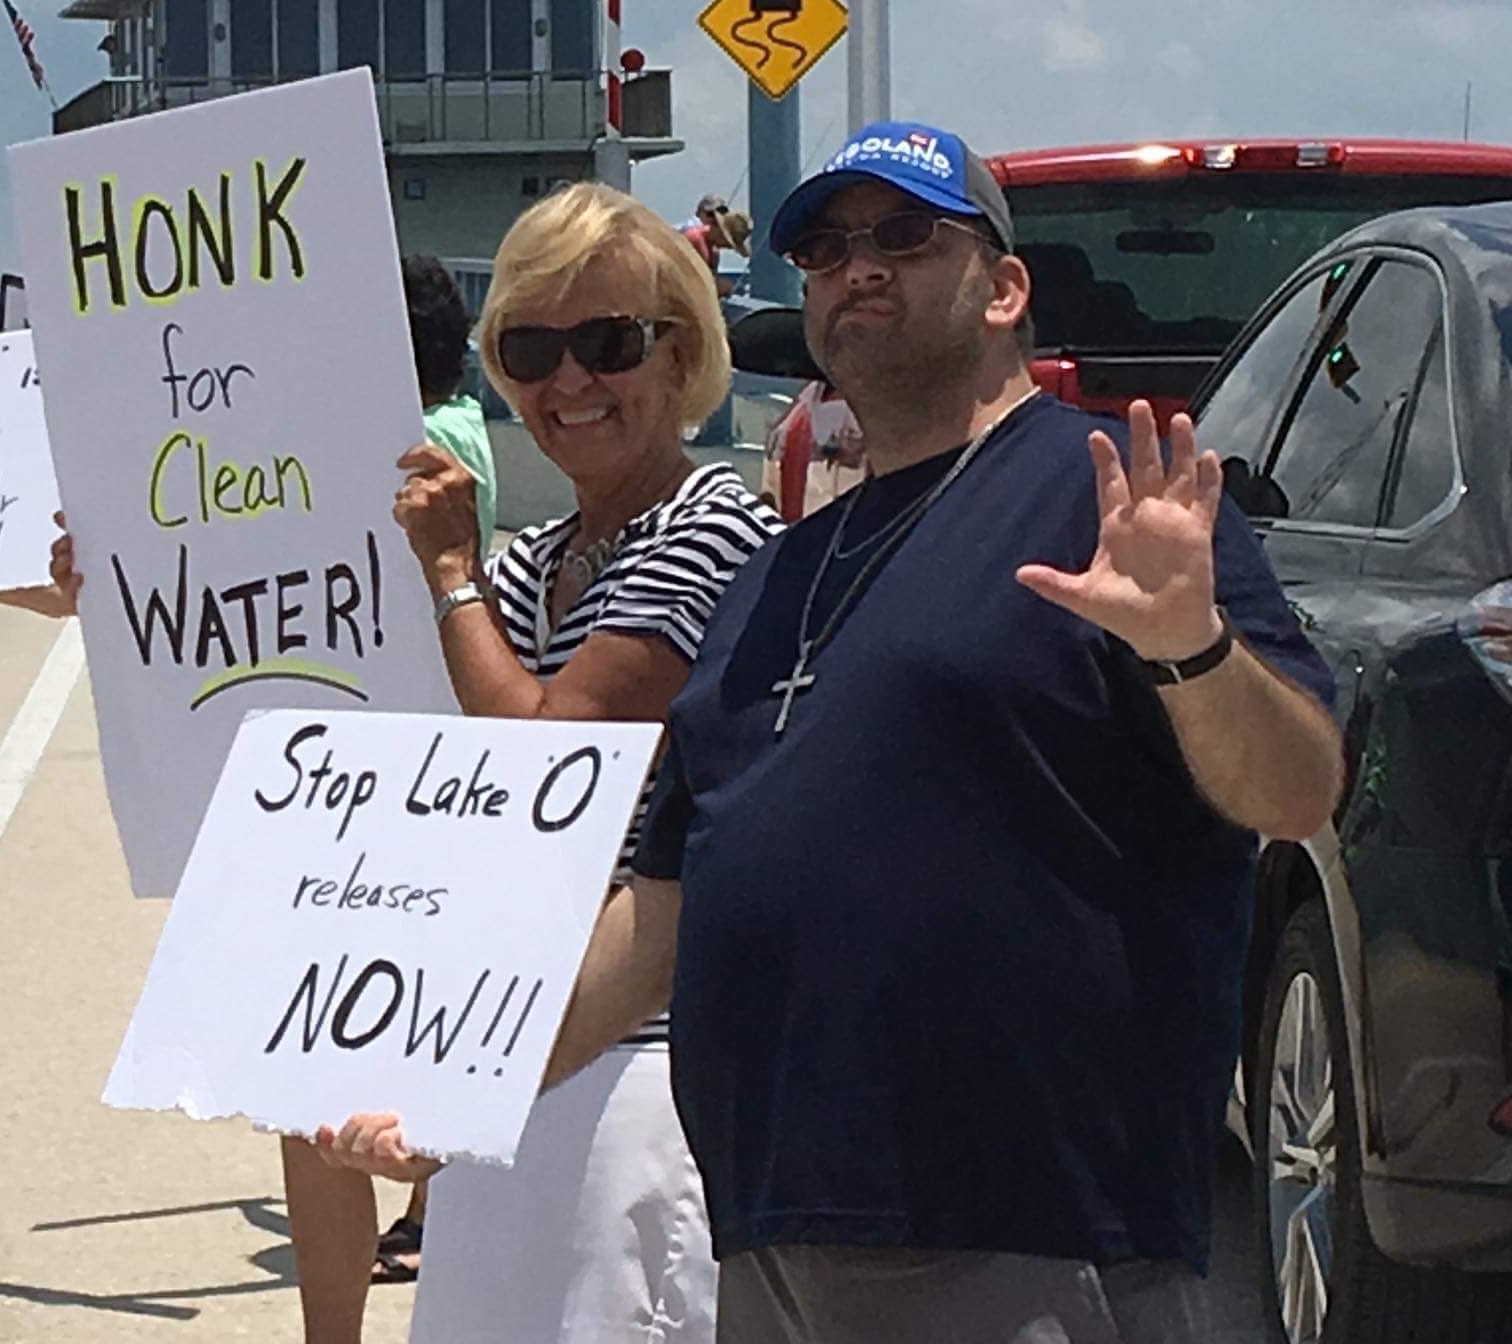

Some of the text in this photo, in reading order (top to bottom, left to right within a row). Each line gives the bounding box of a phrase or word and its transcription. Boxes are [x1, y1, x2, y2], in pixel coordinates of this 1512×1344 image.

[64, 158, 307, 312] HONK
[162, 323, 255, 418] for
[149, 433, 312, 527] Clean
[111, 530, 384, 669] WATER!
[254, 723, 377, 842] Stop
[405, 732, 510, 818] Lake
[292, 852, 449, 916] releases
